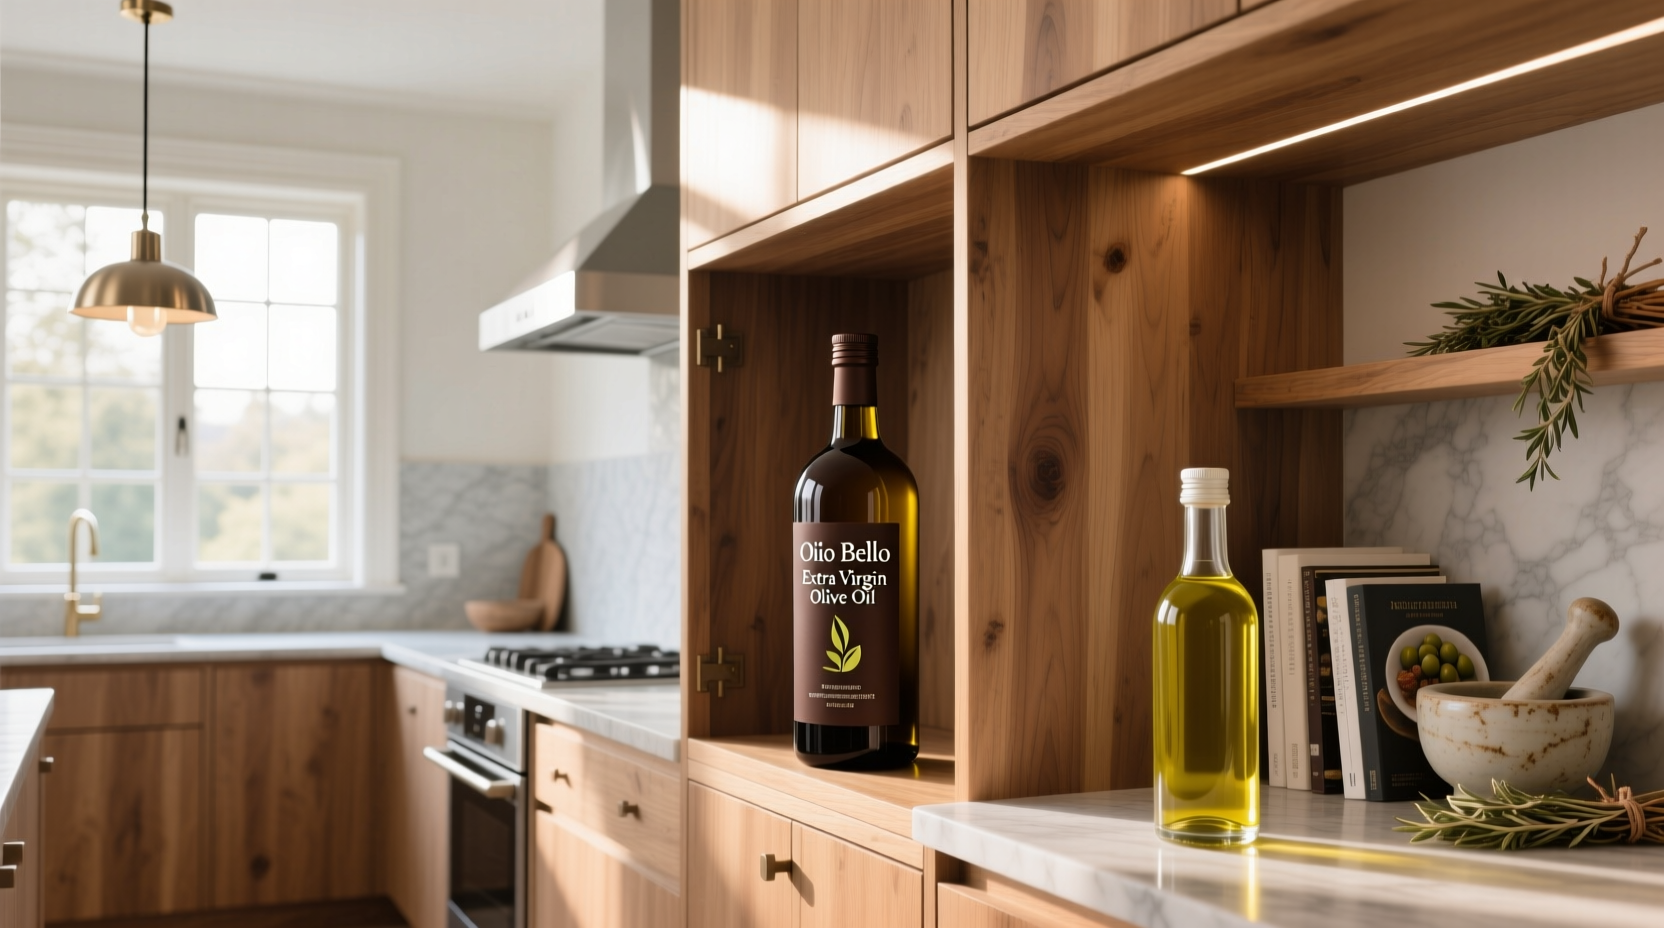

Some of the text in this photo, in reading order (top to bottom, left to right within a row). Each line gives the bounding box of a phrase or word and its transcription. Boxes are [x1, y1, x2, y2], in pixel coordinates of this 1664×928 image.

[841, 540, 891, 562] Bello
[802, 569, 887, 591] Extra Virgin
[810, 588, 875, 604] Olive Oil
